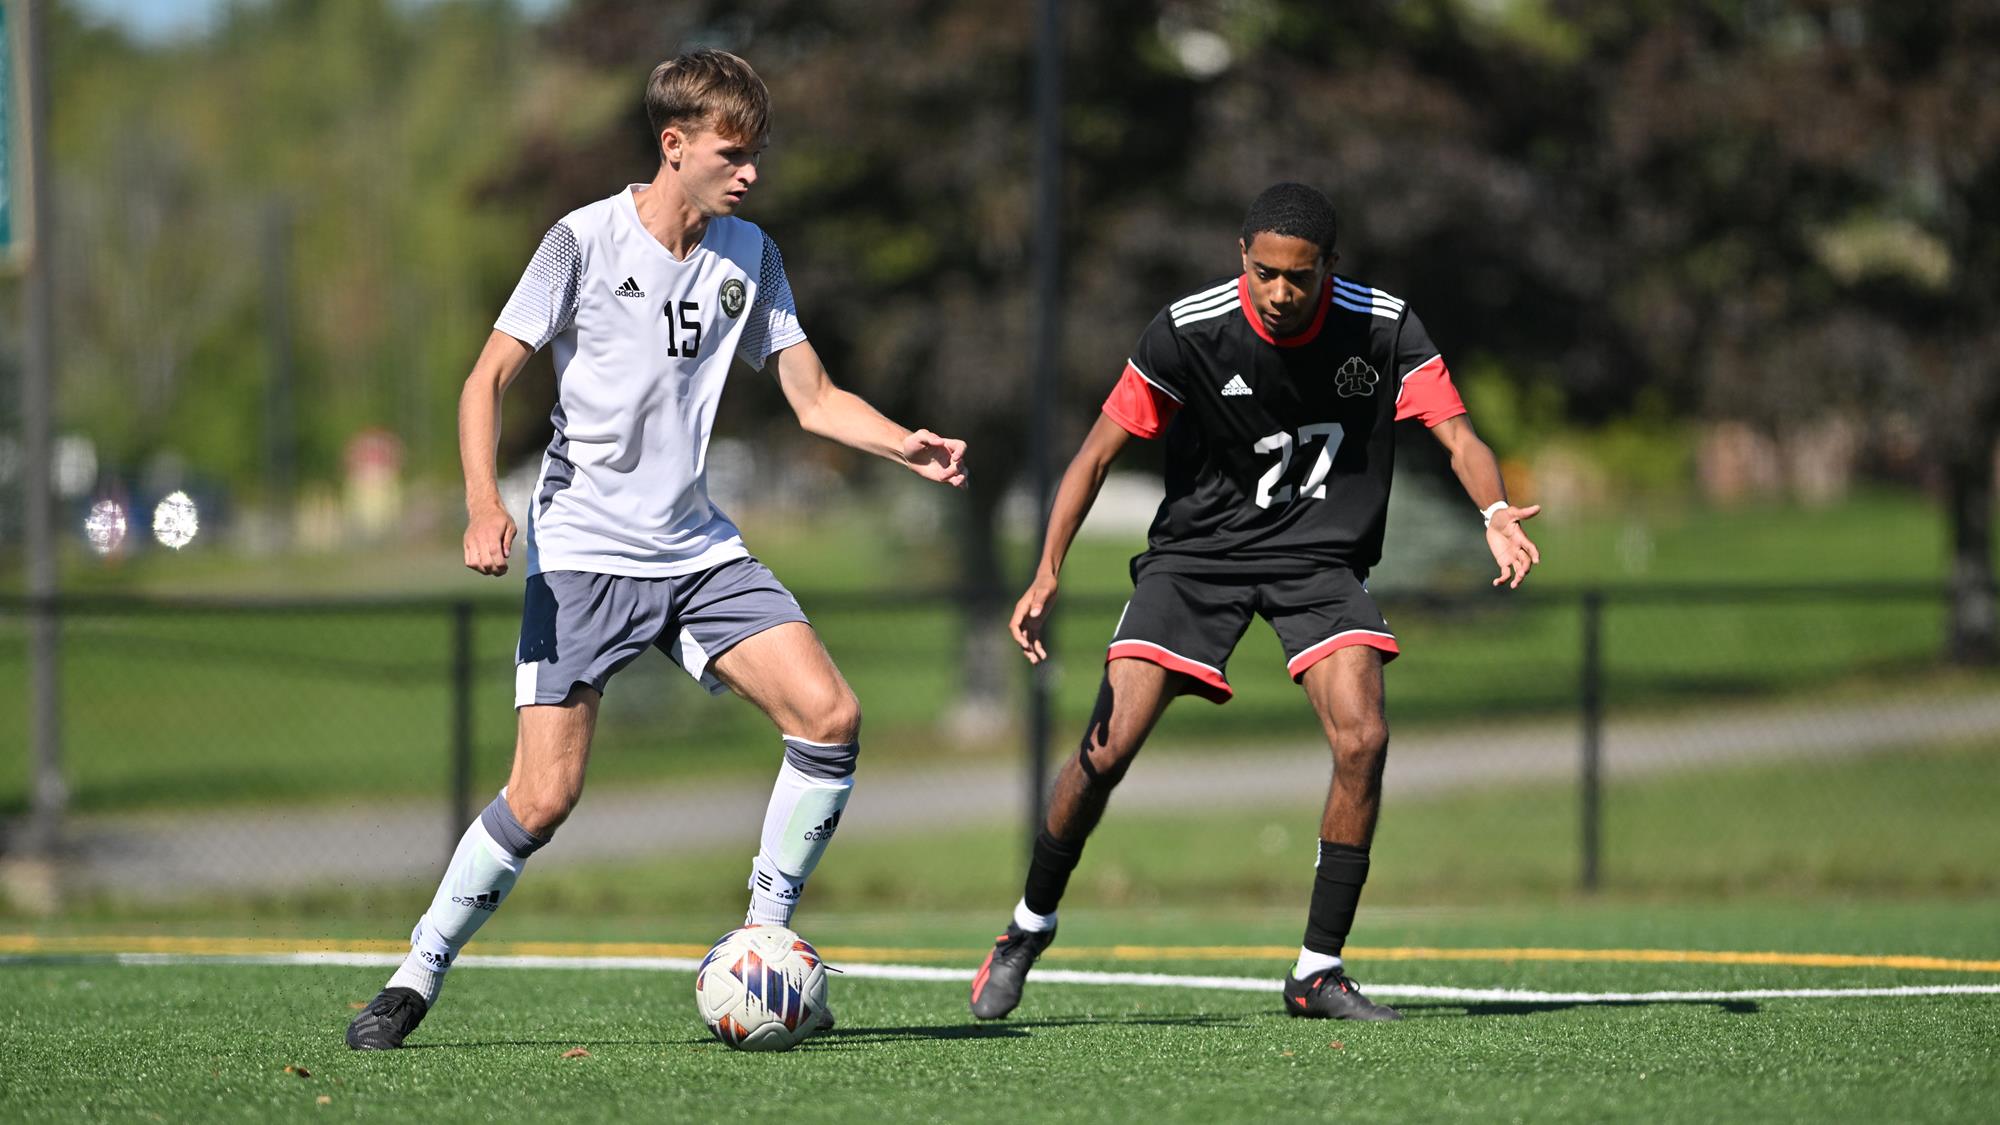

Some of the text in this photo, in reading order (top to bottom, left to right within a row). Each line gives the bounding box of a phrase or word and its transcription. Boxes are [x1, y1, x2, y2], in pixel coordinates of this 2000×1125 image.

[615, 289, 645, 298] adidas
[664, 300, 701, 358] 15
[1254, 423, 1345, 509] 27
